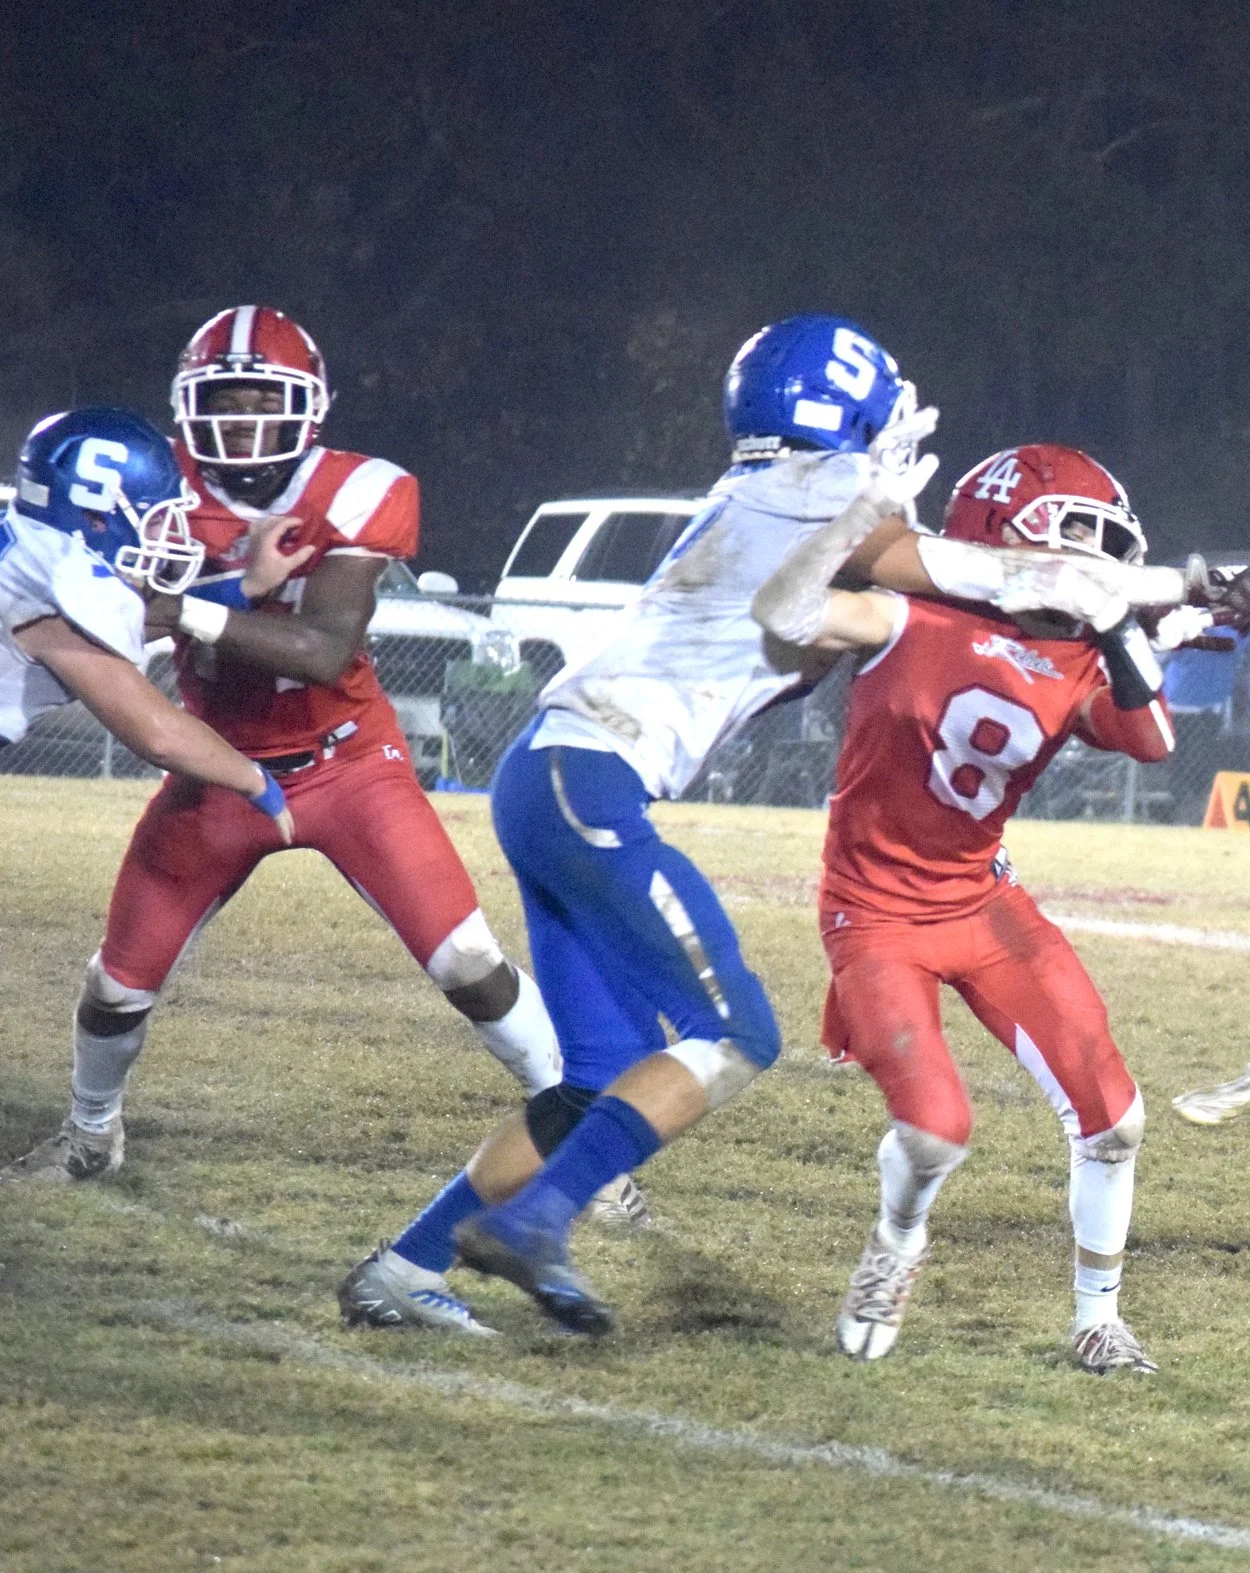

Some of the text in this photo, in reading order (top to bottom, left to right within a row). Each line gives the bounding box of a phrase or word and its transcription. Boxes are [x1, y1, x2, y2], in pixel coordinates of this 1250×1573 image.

[825, 327, 878, 401] S
[69, 437, 129, 512] S
[974, 449, 1022, 504] LA
[928, 687, 1045, 821] 8
